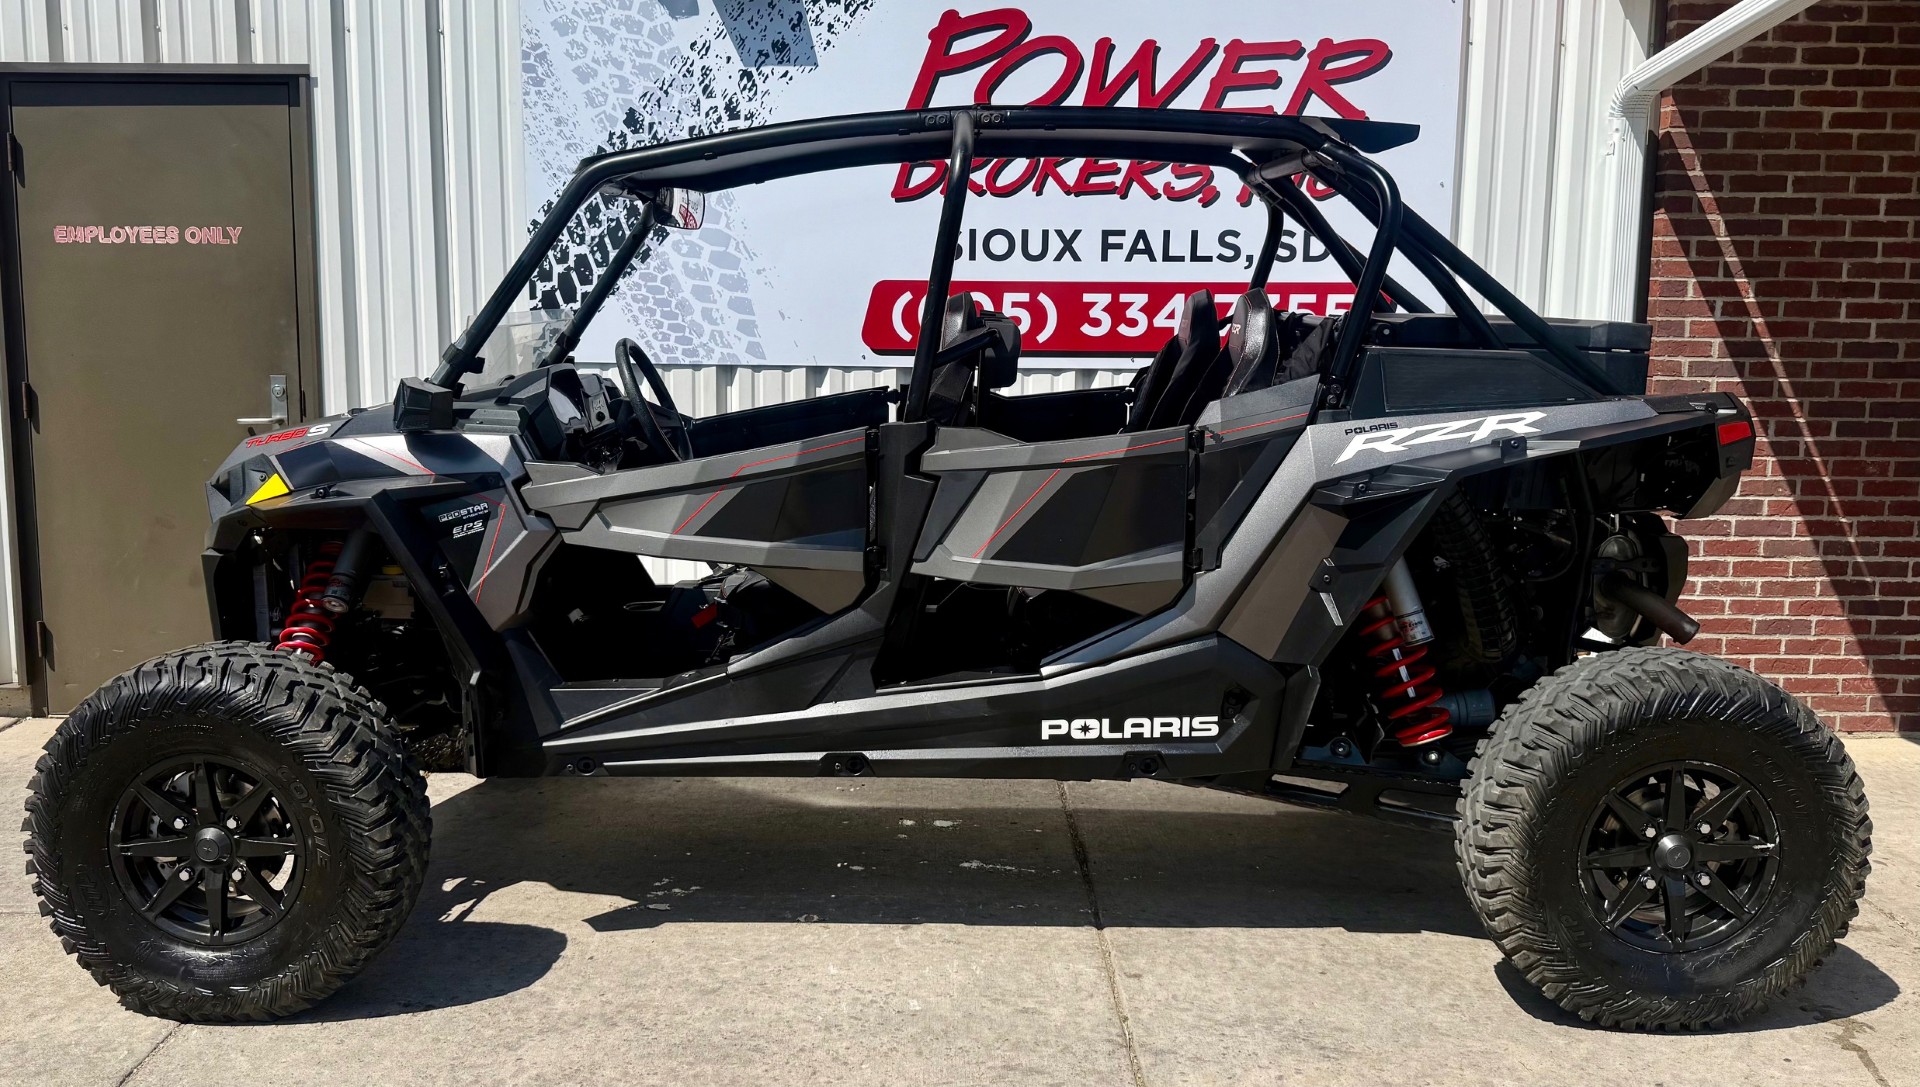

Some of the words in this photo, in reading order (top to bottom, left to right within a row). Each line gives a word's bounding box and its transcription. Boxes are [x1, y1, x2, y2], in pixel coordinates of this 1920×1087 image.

[905, 7, 1393, 120] POWER
[54, 225, 180, 244] EMPLOYEES
[184, 226, 243, 244] ONLY
[1101, 229, 1254, 269] FALLS,
[891, 290, 1058, 345] (5)
[245, 427, 310, 448] TURBO
[306, 423, 332, 437] S
[1331, 411, 1548, 467] RZR
[1344, 421, 1399, 436] POLARIS
[452, 519, 483, 534] EPS
[1041, 715, 1220, 741] POLARIS
